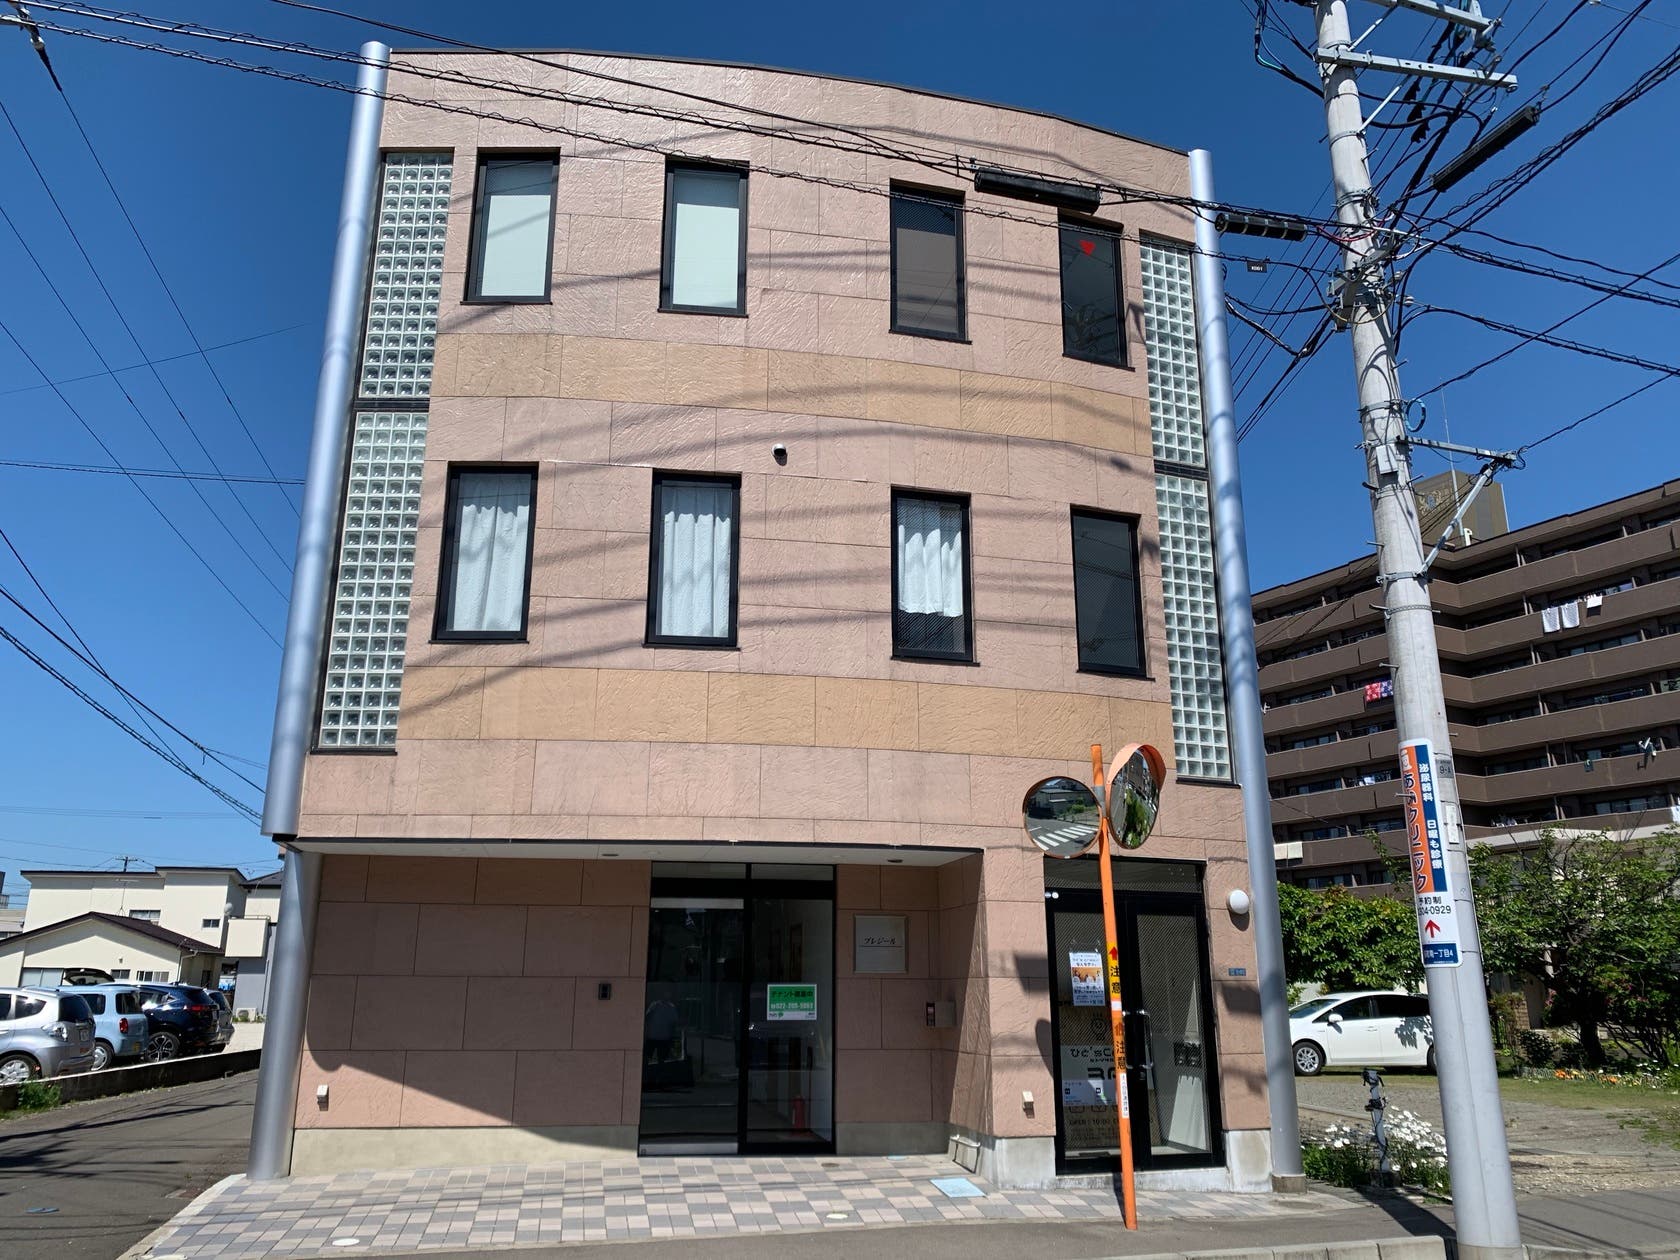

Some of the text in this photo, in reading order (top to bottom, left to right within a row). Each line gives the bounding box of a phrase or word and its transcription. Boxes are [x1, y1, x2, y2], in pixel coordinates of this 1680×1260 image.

[1418, 763, 1443, 869] 泌尿器科 日曜も診療
[1110, 965, 1121, 994] 注意
[1115, 1041, 1126, 1071] 注意
